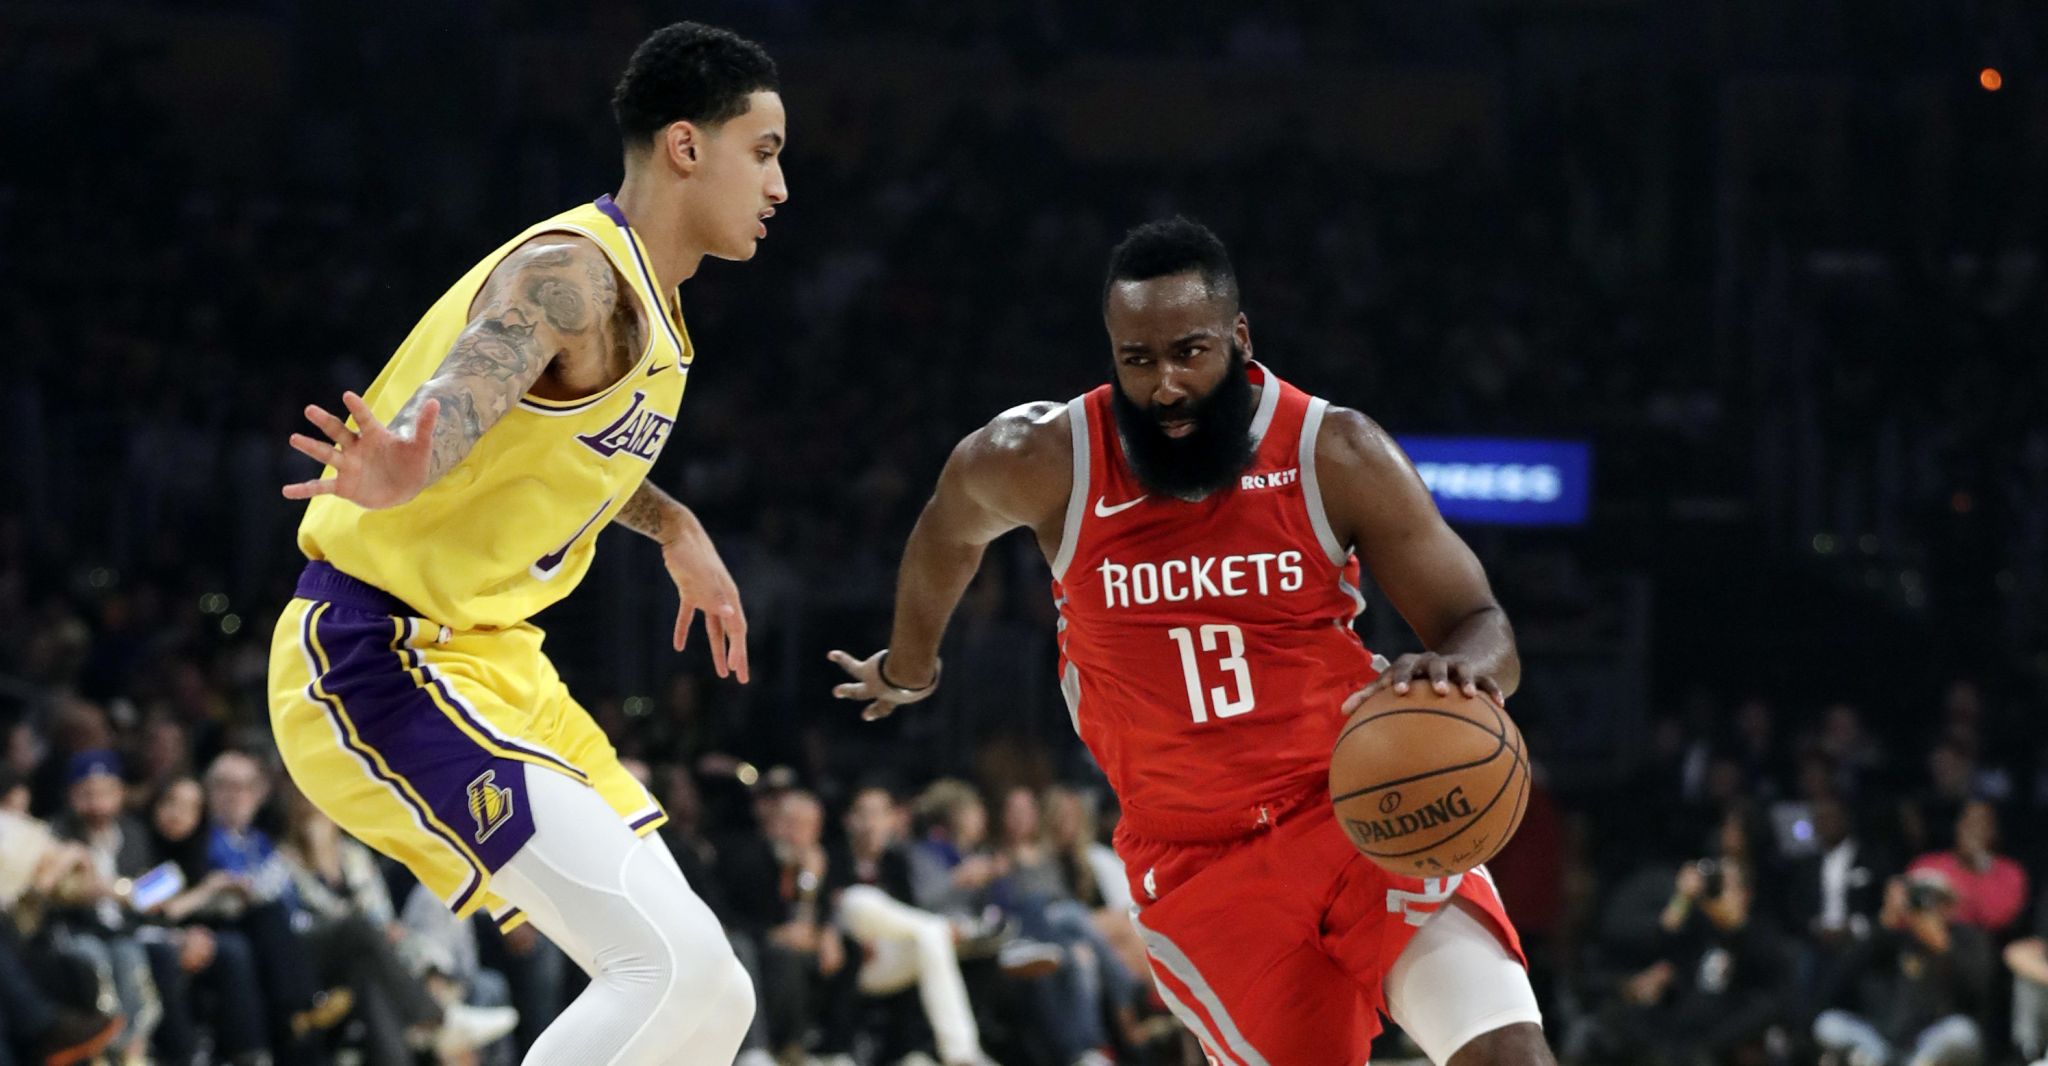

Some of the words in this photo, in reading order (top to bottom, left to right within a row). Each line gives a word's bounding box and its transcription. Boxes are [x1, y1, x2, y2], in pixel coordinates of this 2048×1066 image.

[574, 391, 674, 460] LAKE
[1097, 550, 1304, 609] ROCKETS
[1168, 624, 1255, 723] 13
